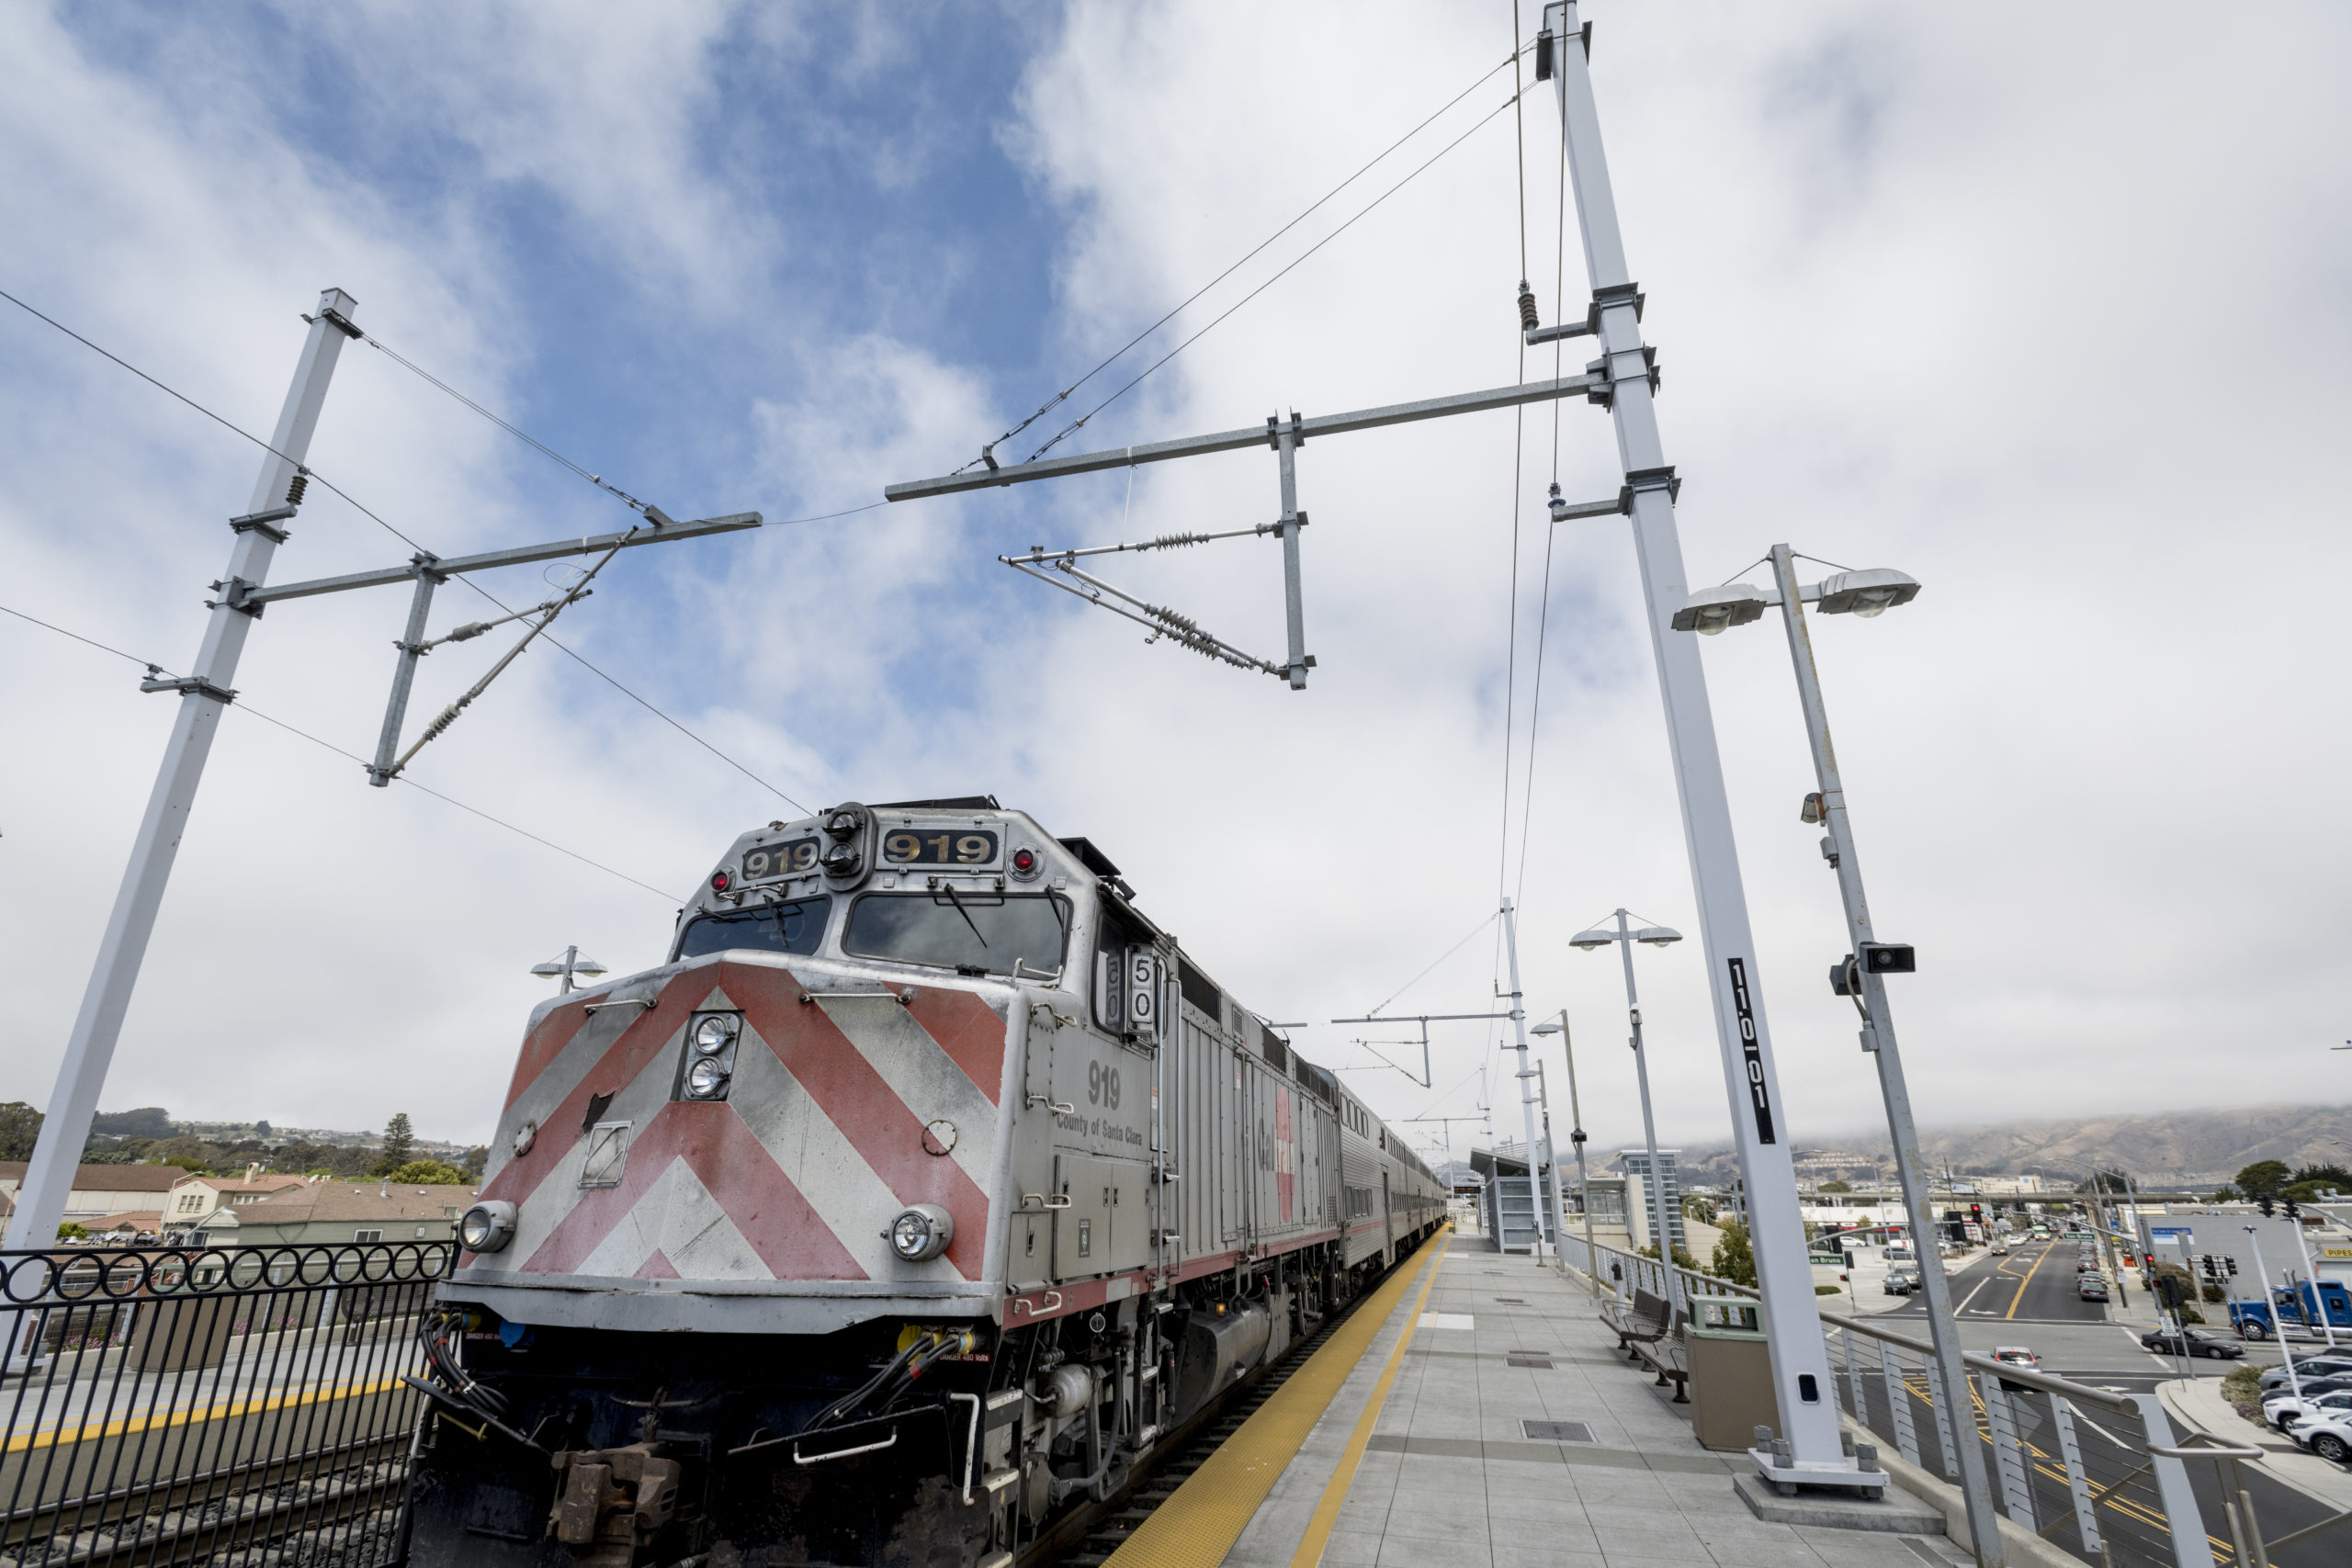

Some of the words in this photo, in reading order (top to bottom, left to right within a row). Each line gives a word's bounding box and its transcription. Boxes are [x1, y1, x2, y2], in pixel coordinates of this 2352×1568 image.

[745, 841, 819, 880] 919
[887, 834, 991, 863] 919
[1733, 964, 1766, 1108] 11.0-01
[1088, 1059, 1121, 1111] 919
[1057, 1112, 1088, 1137] County
[1091, 1118, 1100, 1136] of
[1102, 1119, 1123, 1142] Santa
[1125, 1126, 1142, 1145] Clara
